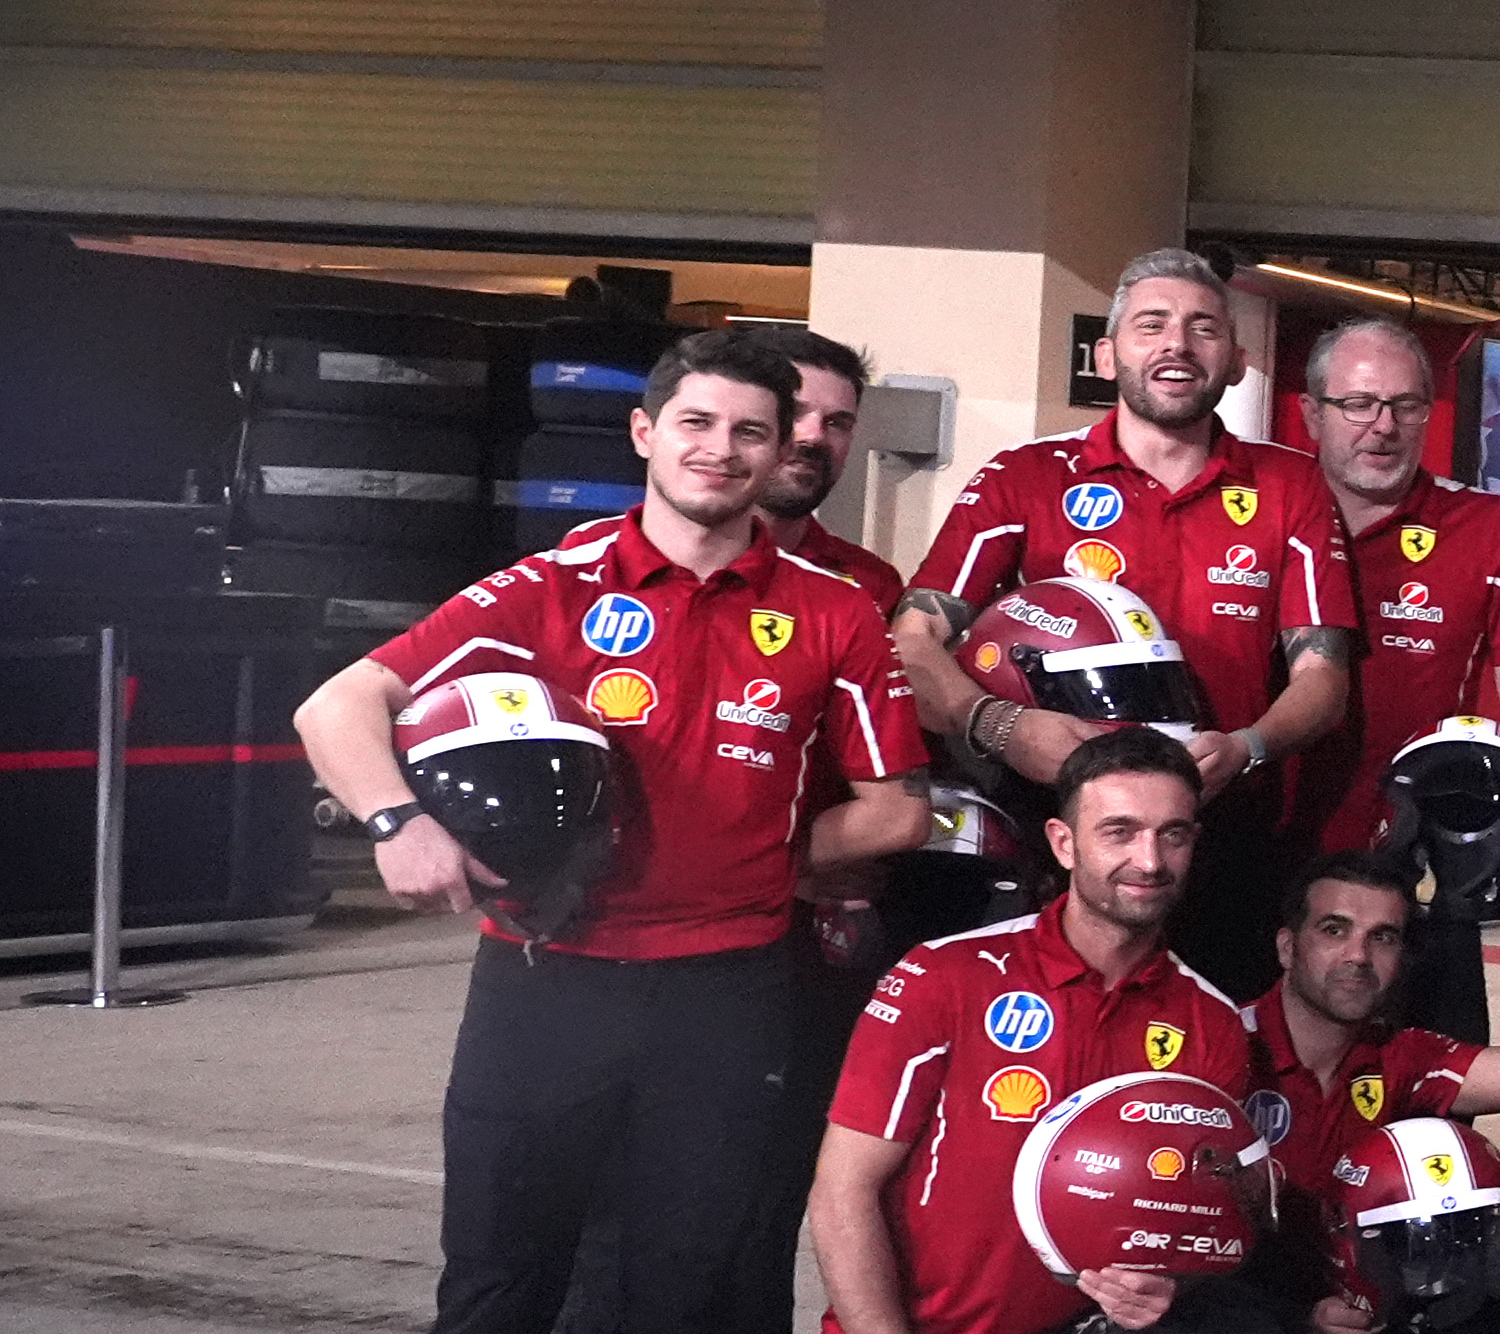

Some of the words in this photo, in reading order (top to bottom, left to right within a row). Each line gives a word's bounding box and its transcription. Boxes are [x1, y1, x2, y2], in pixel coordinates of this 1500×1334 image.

[1068, 483, 1118, 531] hp
[1209, 567, 1270, 589] UniCredit
[1008, 599, 1078, 640] UniCredit
[1212, 601, 1260, 620] CEVA
[1380, 602, 1443, 624] UniCredit
[590, 593, 648, 657] hp
[1382, 634, 1436, 652] CEVA
[717, 701, 791, 733] UniCredit
[718, 743, 775, 766] CEVA
[990, 991, 1047, 1052] hp
[1150, 1103, 1232, 1130] UniCredit
[1075, 1149, 1121, 1171] ITALIA
[1133, 1198, 1187, 1214] RICHARD
[1190, 1205, 1223, 1216] MILLE
[1176, 1234, 1243, 1256] CEVA
